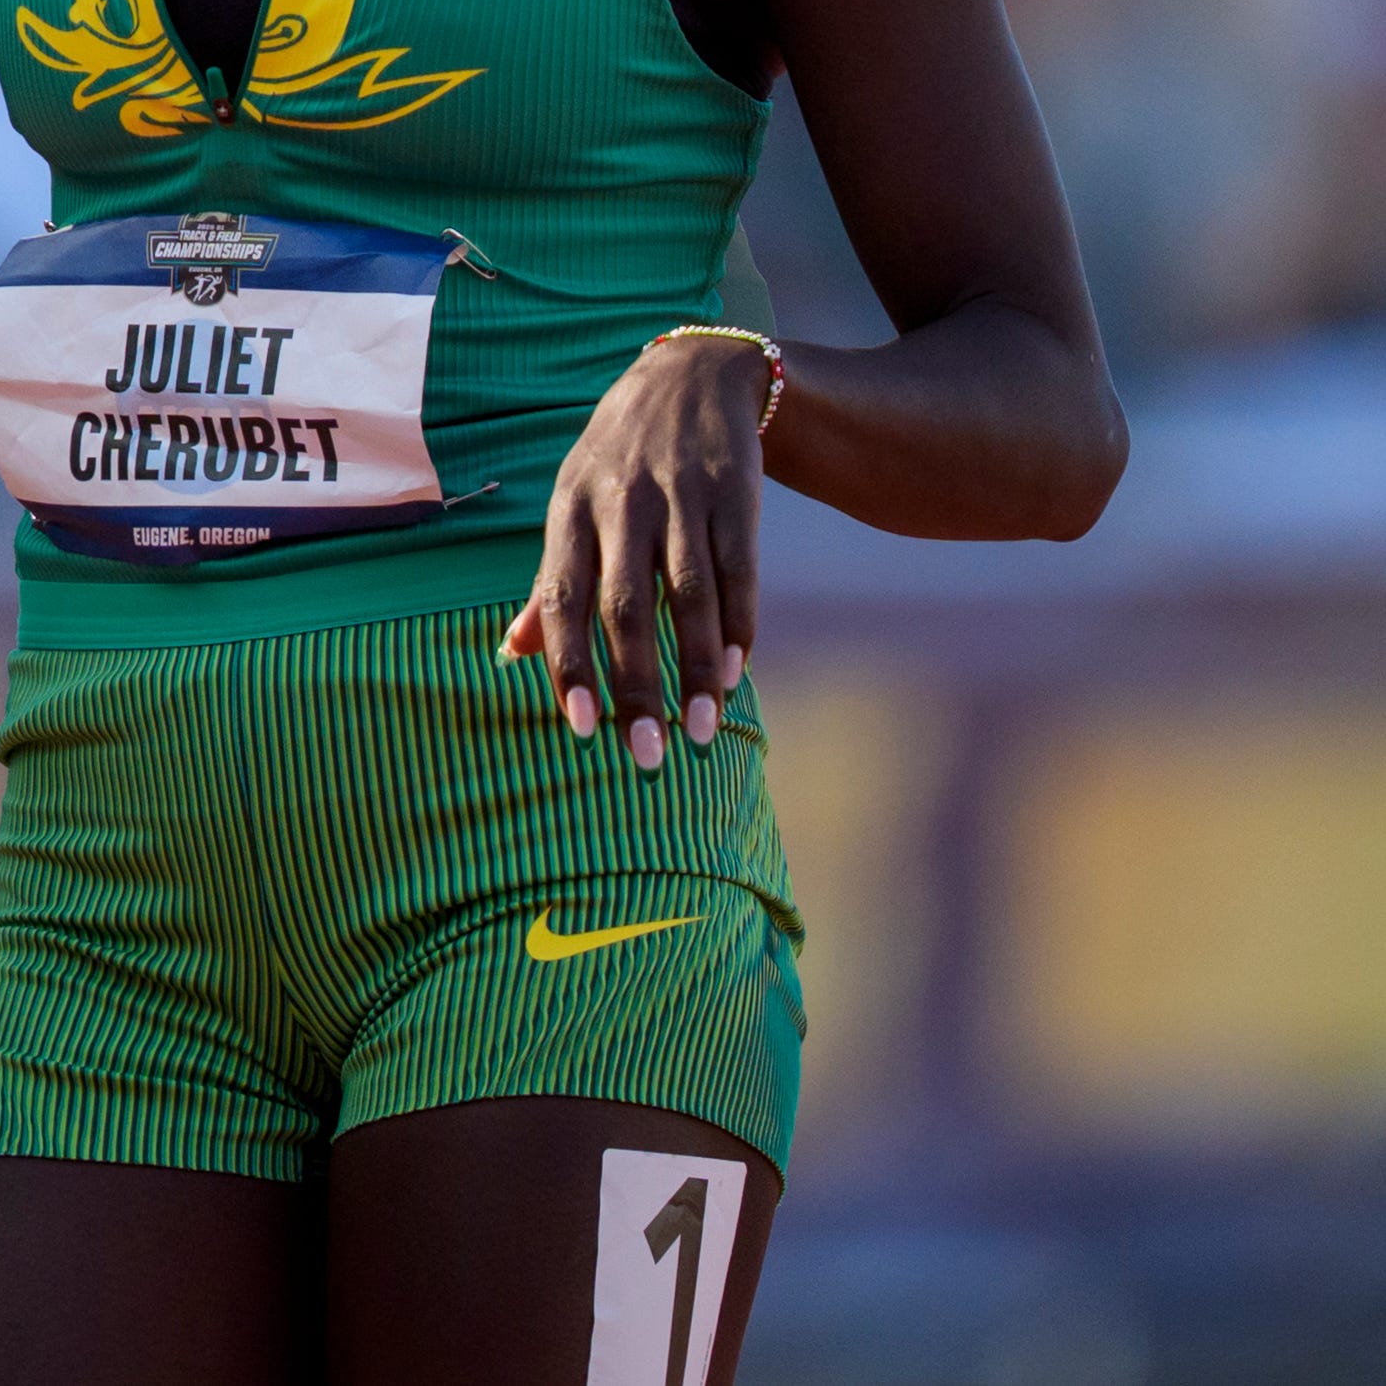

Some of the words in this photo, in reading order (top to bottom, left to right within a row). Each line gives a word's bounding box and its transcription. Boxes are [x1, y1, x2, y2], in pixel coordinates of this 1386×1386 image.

[155, 241, 265, 260] CHAMPIONSHIPS
[179, 229, 208, 241] TRACK
[216, 231, 243, 243] FIELD
[104, 324, 294, 396] JULIET
[69, 411, 340, 483] CHERUBET
[133, 526, 195, 547] EUGENE,
[199, 527, 271, 546] OREGON
[643, 1176, 709, 1386] 1
